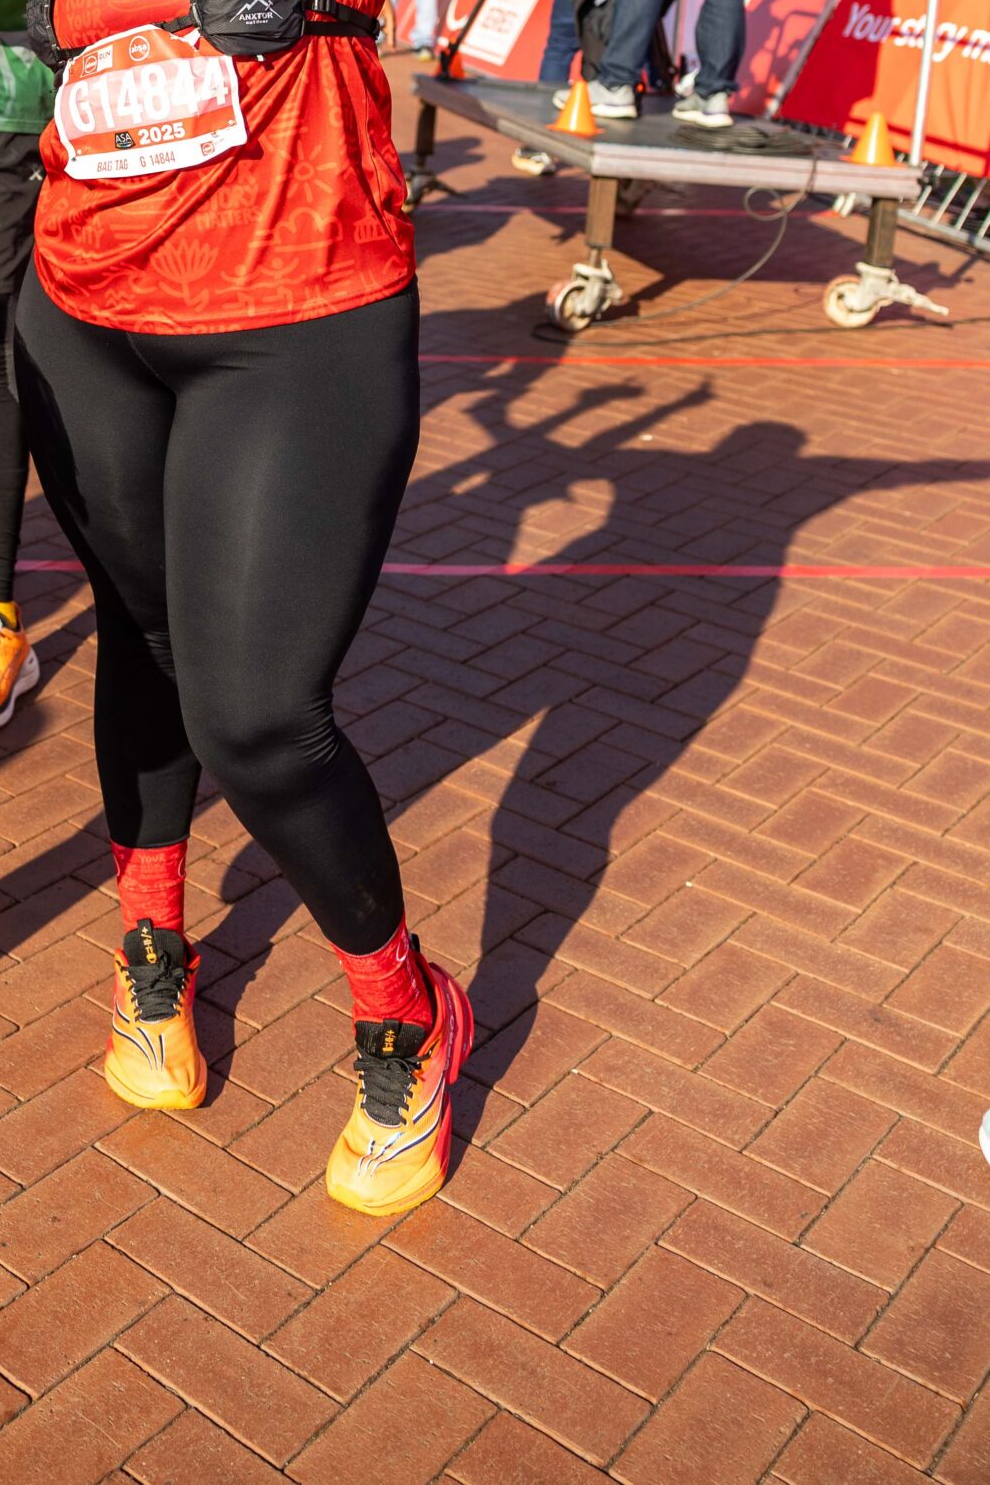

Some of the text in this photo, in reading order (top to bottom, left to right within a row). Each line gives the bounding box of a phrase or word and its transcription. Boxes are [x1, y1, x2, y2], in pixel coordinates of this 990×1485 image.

[239, 11, 274, 21] ANXTOR
[842, 2, 901, 43] Your
[131, 43, 148, 54] absa
[67, 58, 229, 133] G14844
[115, 133, 132, 145] ASA
[137, 122, 186, 146] 2025
[96, 150, 176, 173] BAG TAG G 14844
[207, 184, 259, 211] TORY
